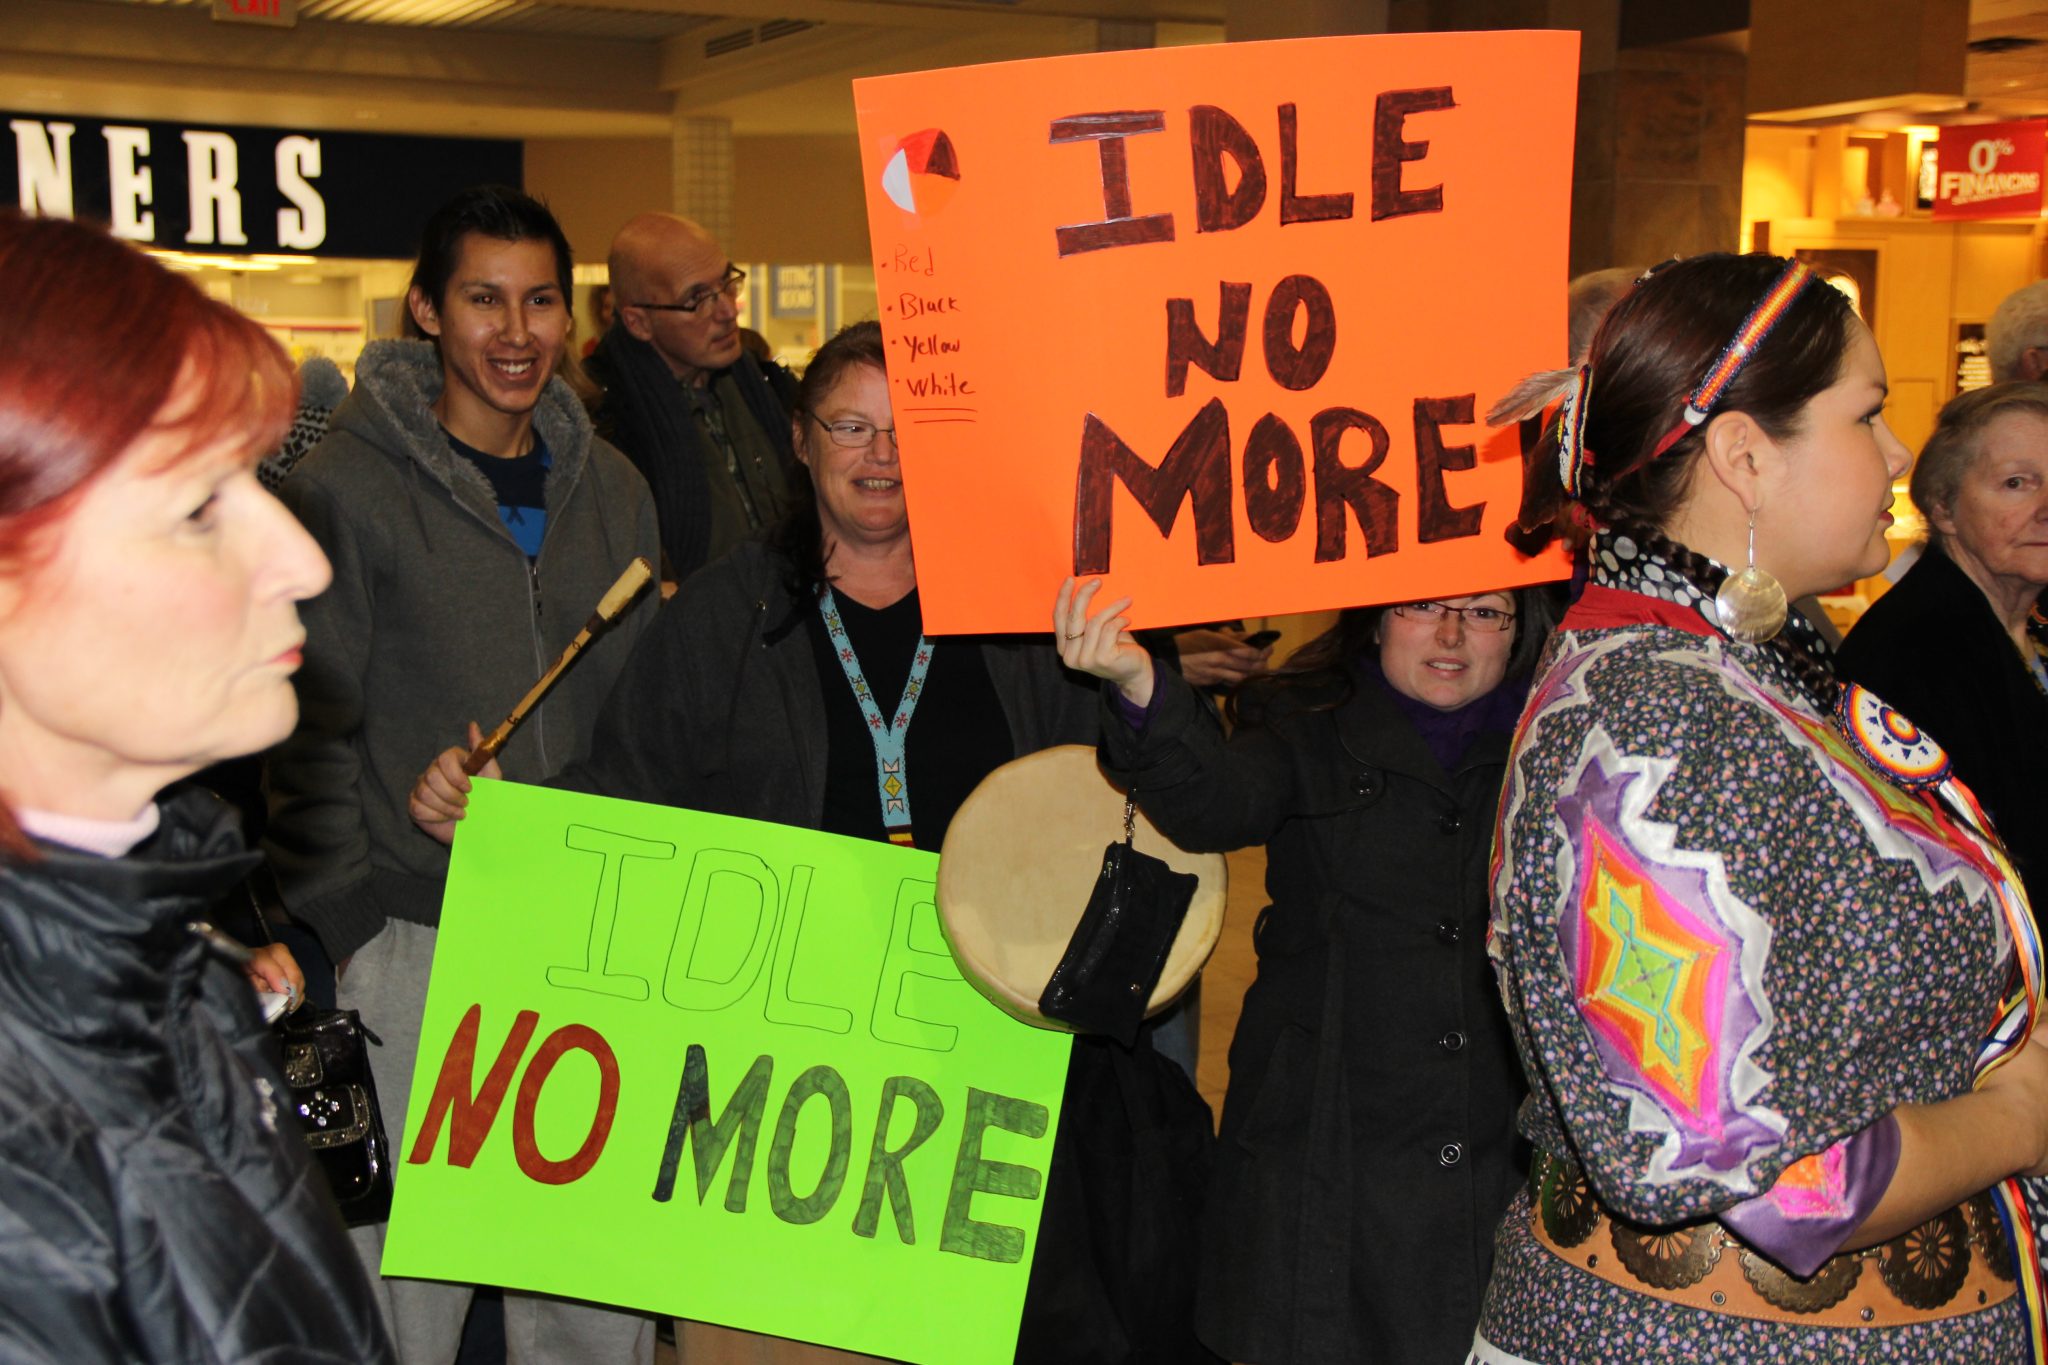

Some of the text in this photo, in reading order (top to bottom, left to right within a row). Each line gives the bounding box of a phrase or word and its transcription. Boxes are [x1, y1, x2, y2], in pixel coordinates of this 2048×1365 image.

[9, 119, 327, 249] NERS
[1049, 85, 1461, 259] IDLE
[894, 243, 935, 277] Red
[898, 292, 961, 320] Black
[903, 334, 961, 363] Yellow
[906, 372, 976, 398] White
[1165, 274, 1336, 398] NO
[1074, 393, 1487, 577] MORE
[546, 824, 966, 1052] IDLE
[406, 1003, 1049, 1263] NO MORE
